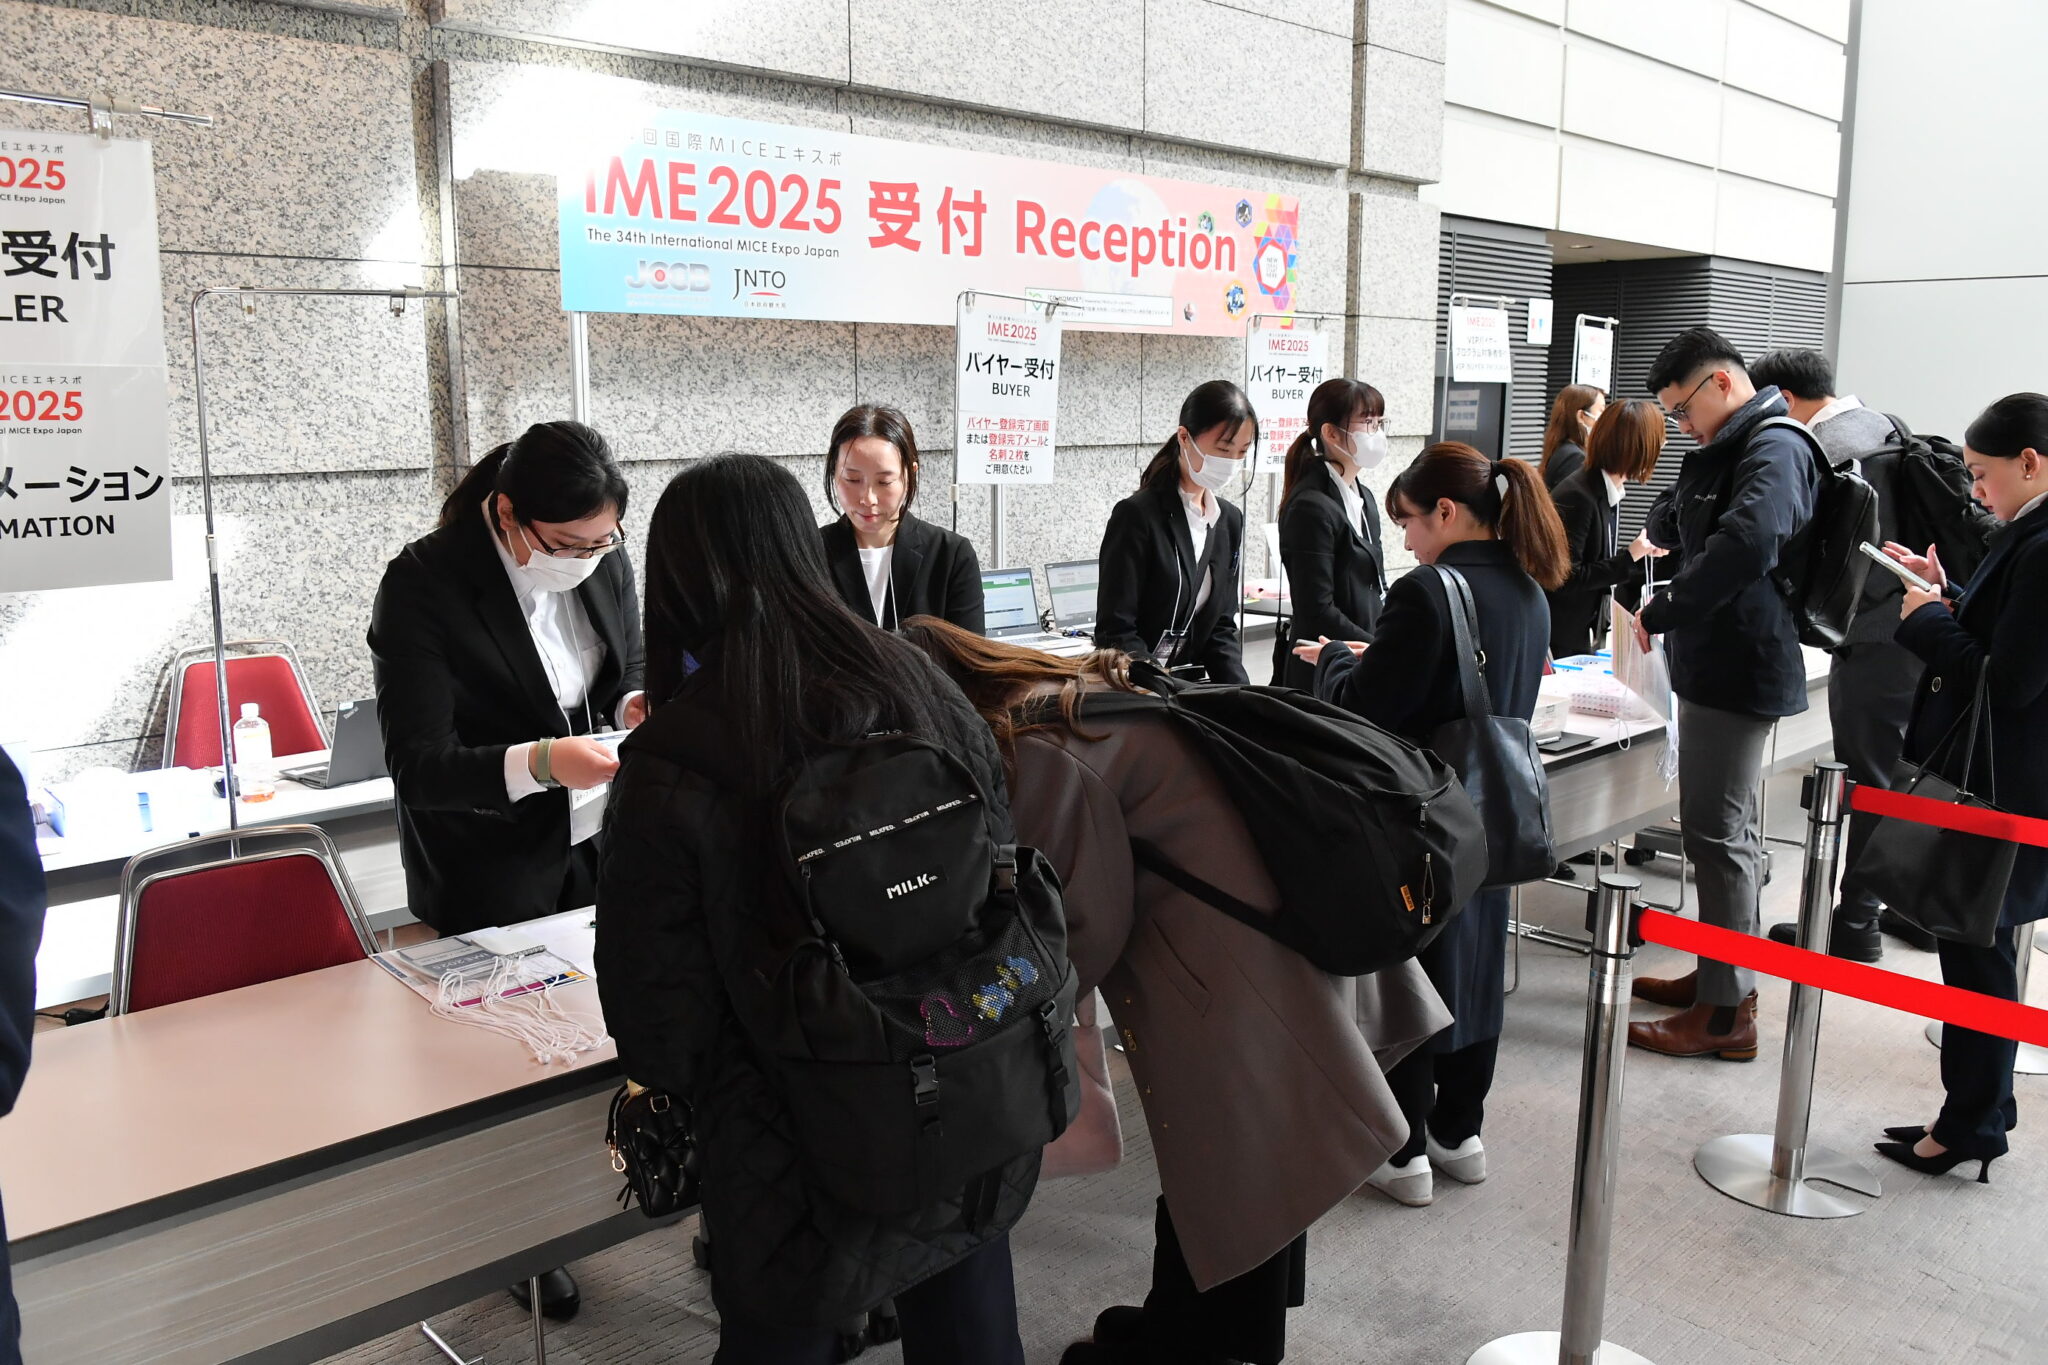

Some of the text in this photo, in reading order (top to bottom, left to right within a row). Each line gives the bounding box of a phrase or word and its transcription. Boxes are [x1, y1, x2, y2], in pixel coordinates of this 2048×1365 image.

[14, 194, 36, 204] Expo
[39, 195, 66, 205] Japan
[585, 156, 1236, 278] IME2025 受付 Reception
[588, 228, 840, 259] The 34th International MICE Expo Japan
[1, 230, 116, 281] 受付
[733, 268, 786, 300] JNTO
[987, 321, 1037, 341] IME2025
[1268, 339, 1309, 352] IME2025
[965, 352, 1055, 380] バイヤー受付
[1250, 364, 1323, 385] バイヤー受付
[992, 382, 1031, 397] BUYER
[1271, 389, 1304, 400] BUYER
[33, 427, 54, 435] Expo
[56, 427, 83, 435] Japan
[967, 417, 1049, 431] バイヤー登録完了画面
[966, 433, 1049, 447] または登録完了メールと
[985, 463, 1032, 475] ご用意ください
